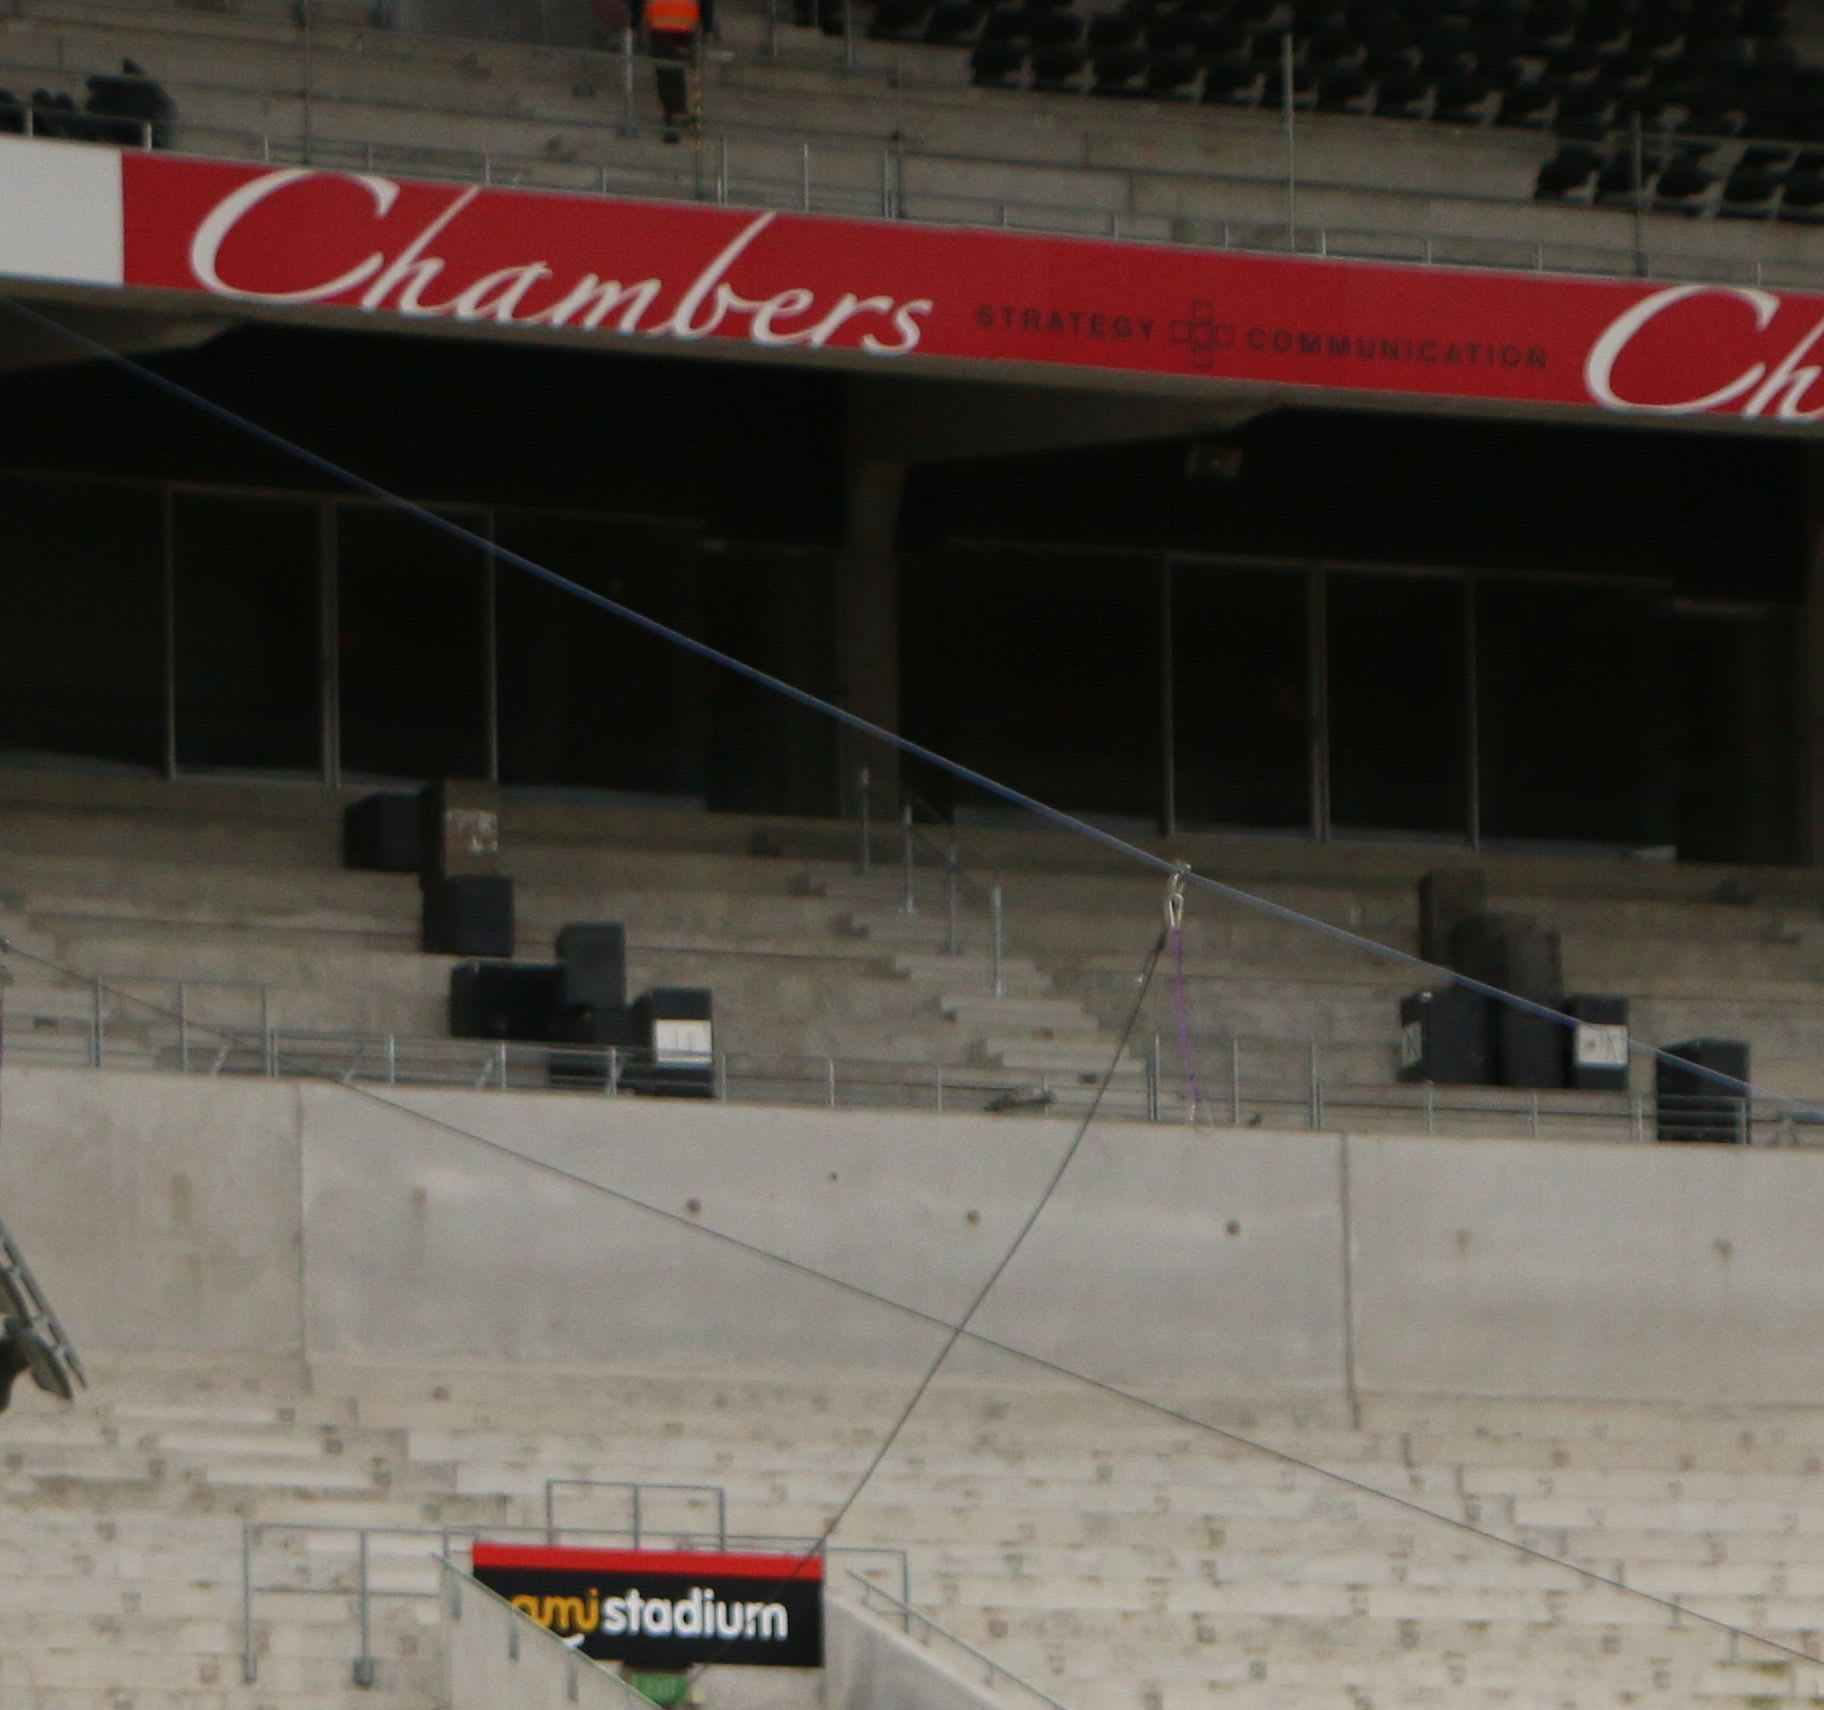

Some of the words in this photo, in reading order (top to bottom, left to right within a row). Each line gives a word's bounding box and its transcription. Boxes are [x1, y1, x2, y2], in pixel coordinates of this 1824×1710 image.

[189, 167, 933, 357] Chambers
[977, 303, 1155, 340] STRATEGY
[1246, 327, 1549, 369] COMMUNICATION
